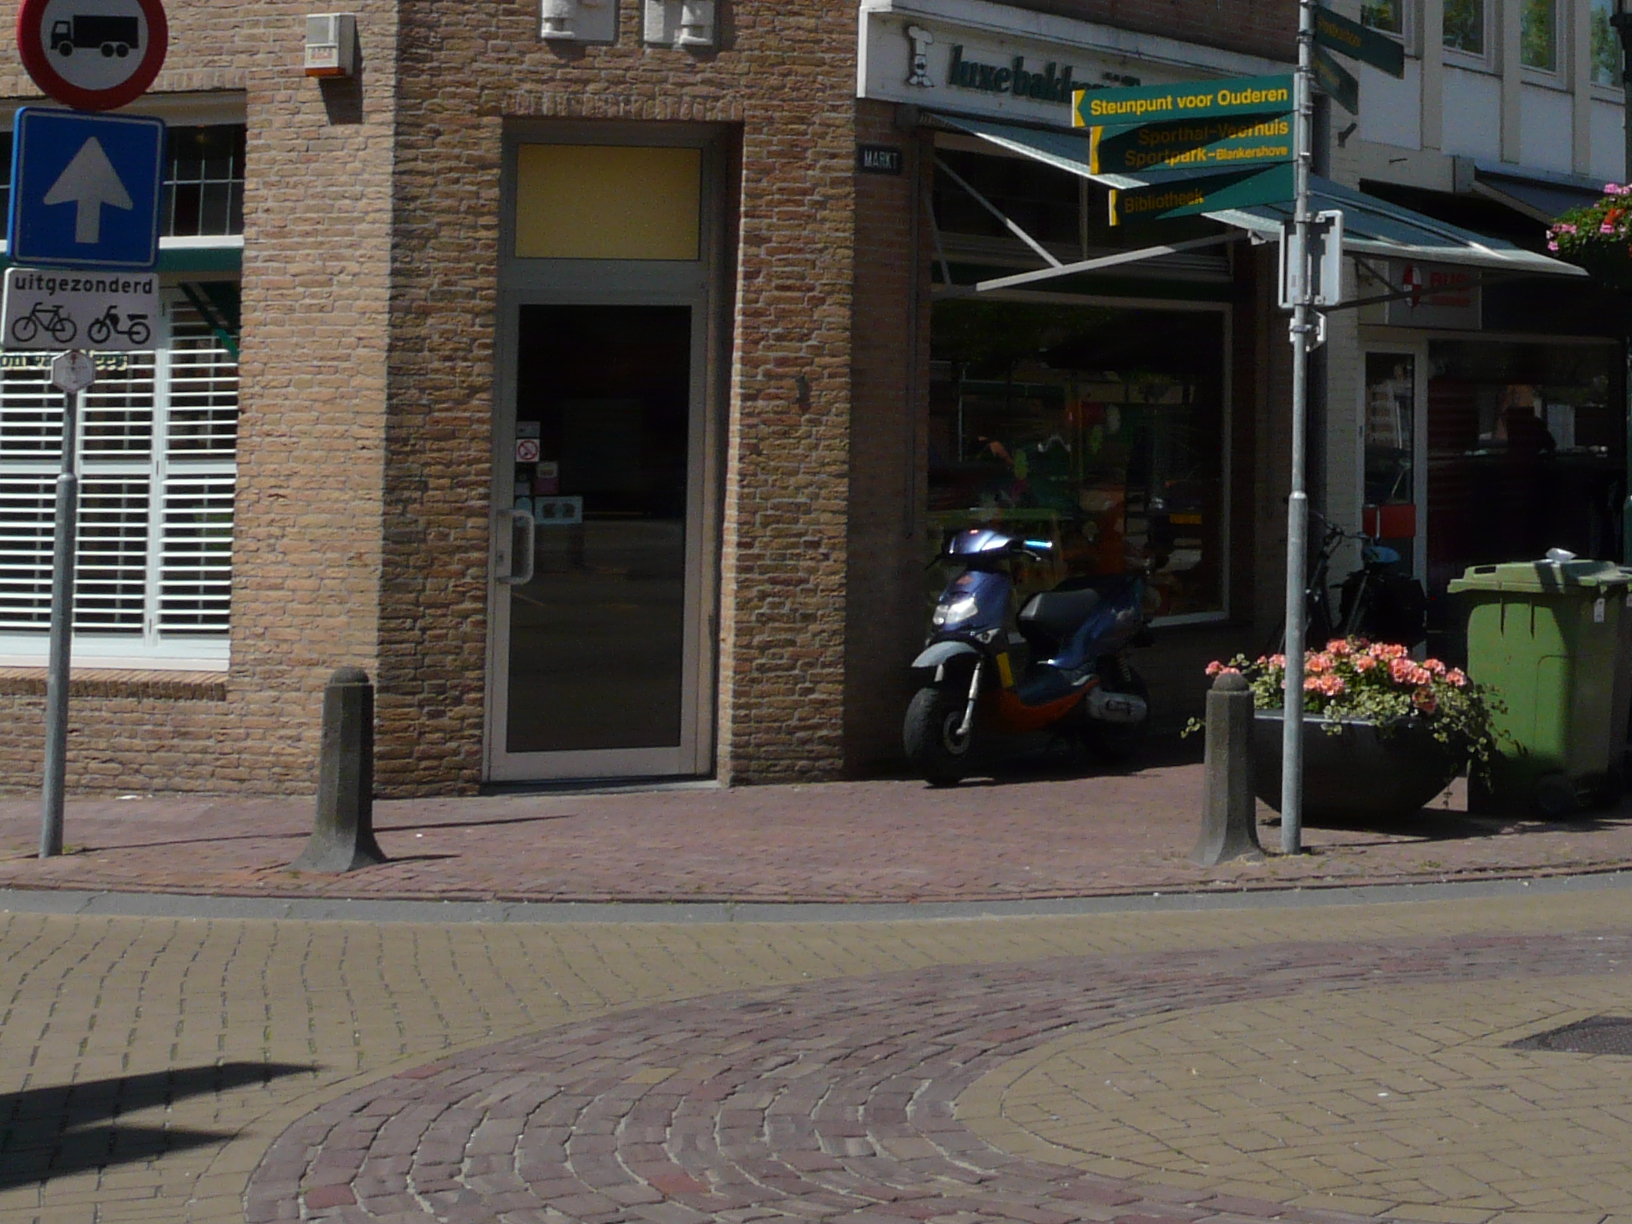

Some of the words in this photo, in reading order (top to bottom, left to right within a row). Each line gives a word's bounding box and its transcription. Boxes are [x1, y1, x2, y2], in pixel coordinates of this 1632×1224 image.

[1090, 94, 1173, 116] Steunpunt
[1177, 94, 1213, 109] voor
[1217, 87, 1288, 106] Ouderen
[864, 149, 899, 169] MARKT
[1124, 187, 1205, 214] Bibliotheek
[15, 273, 153, 296] uitgezonderd
